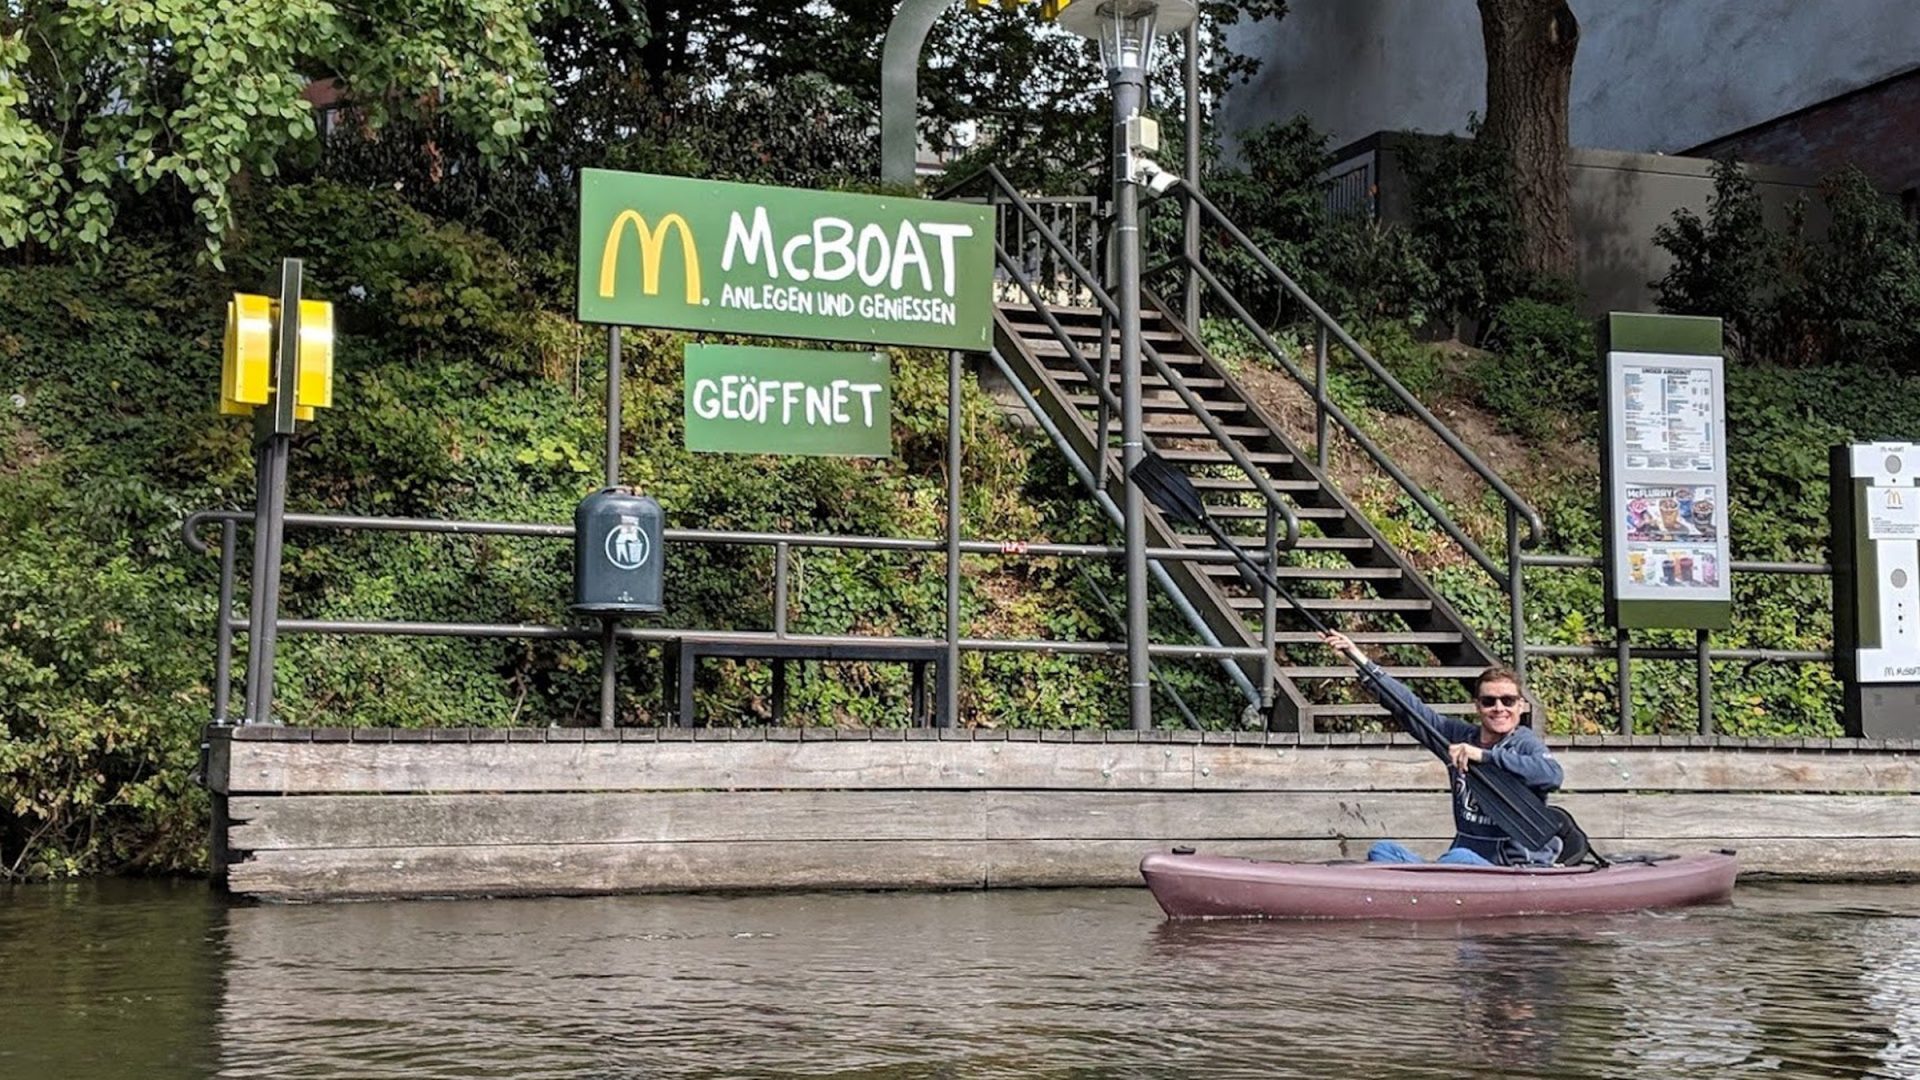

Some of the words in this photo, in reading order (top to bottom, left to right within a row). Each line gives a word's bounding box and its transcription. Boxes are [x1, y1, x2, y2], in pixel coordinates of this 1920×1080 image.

[720, 205, 974, 298] McBOAT
[720, 282, 813, 315] ANLEGEN
[816, 291, 855, 317] UND
[693, 375, 883, 428] GEÖFFNET
